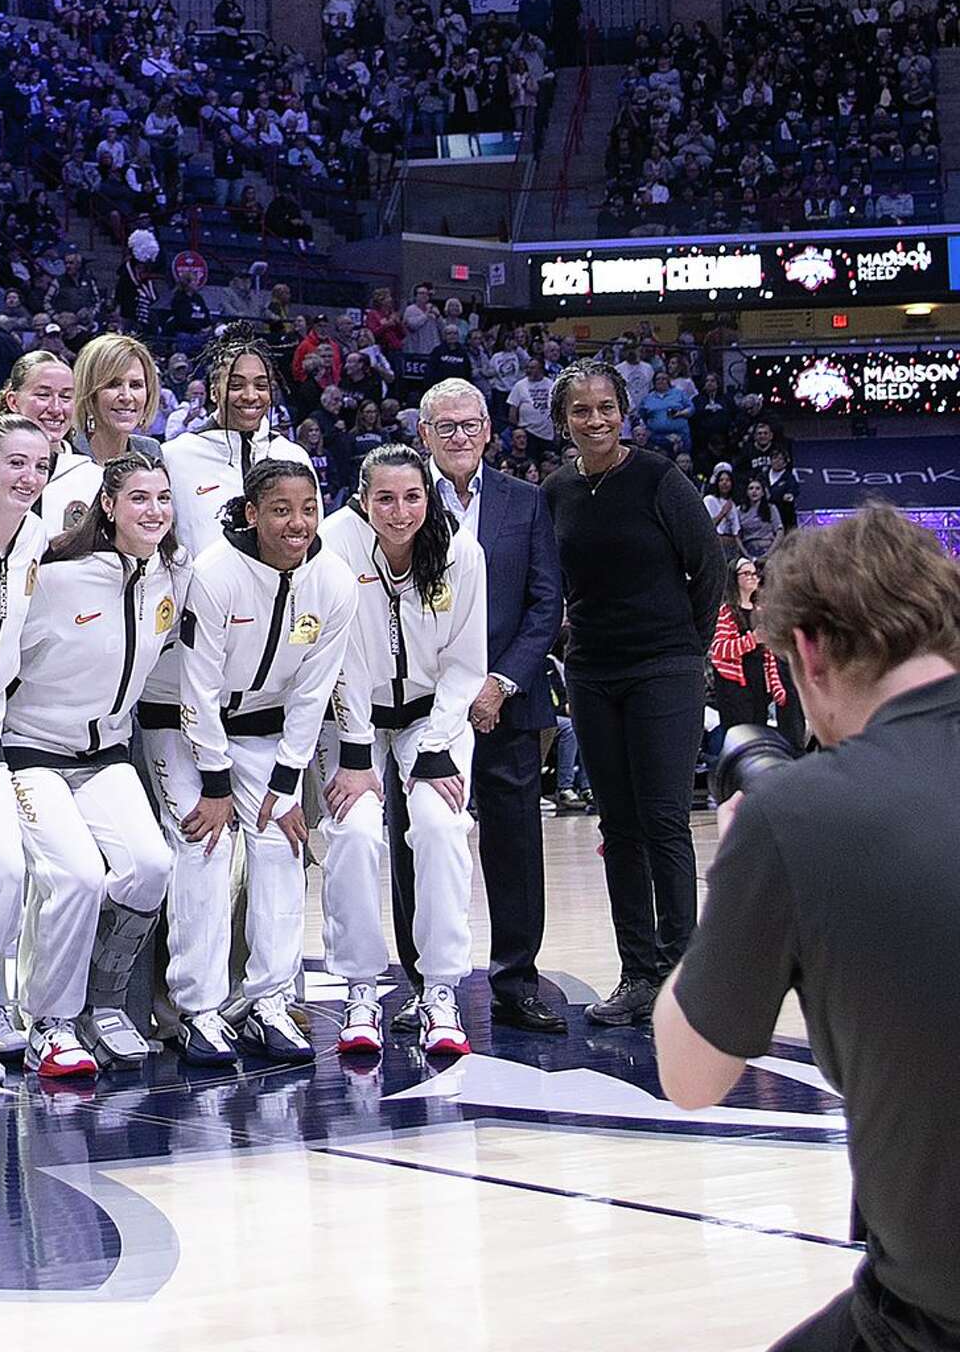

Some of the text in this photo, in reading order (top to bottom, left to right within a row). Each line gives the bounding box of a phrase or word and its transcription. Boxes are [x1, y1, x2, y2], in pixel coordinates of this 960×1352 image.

[857, 250, 932, 268] MADISON
[858, 266, 900, 281] REED
[406, 361, 427, 373] SEC
[863, 363, 959, 383] MADISON
[865, 382, 914, 400] REED
[822, 467, 960, 485] Bank
